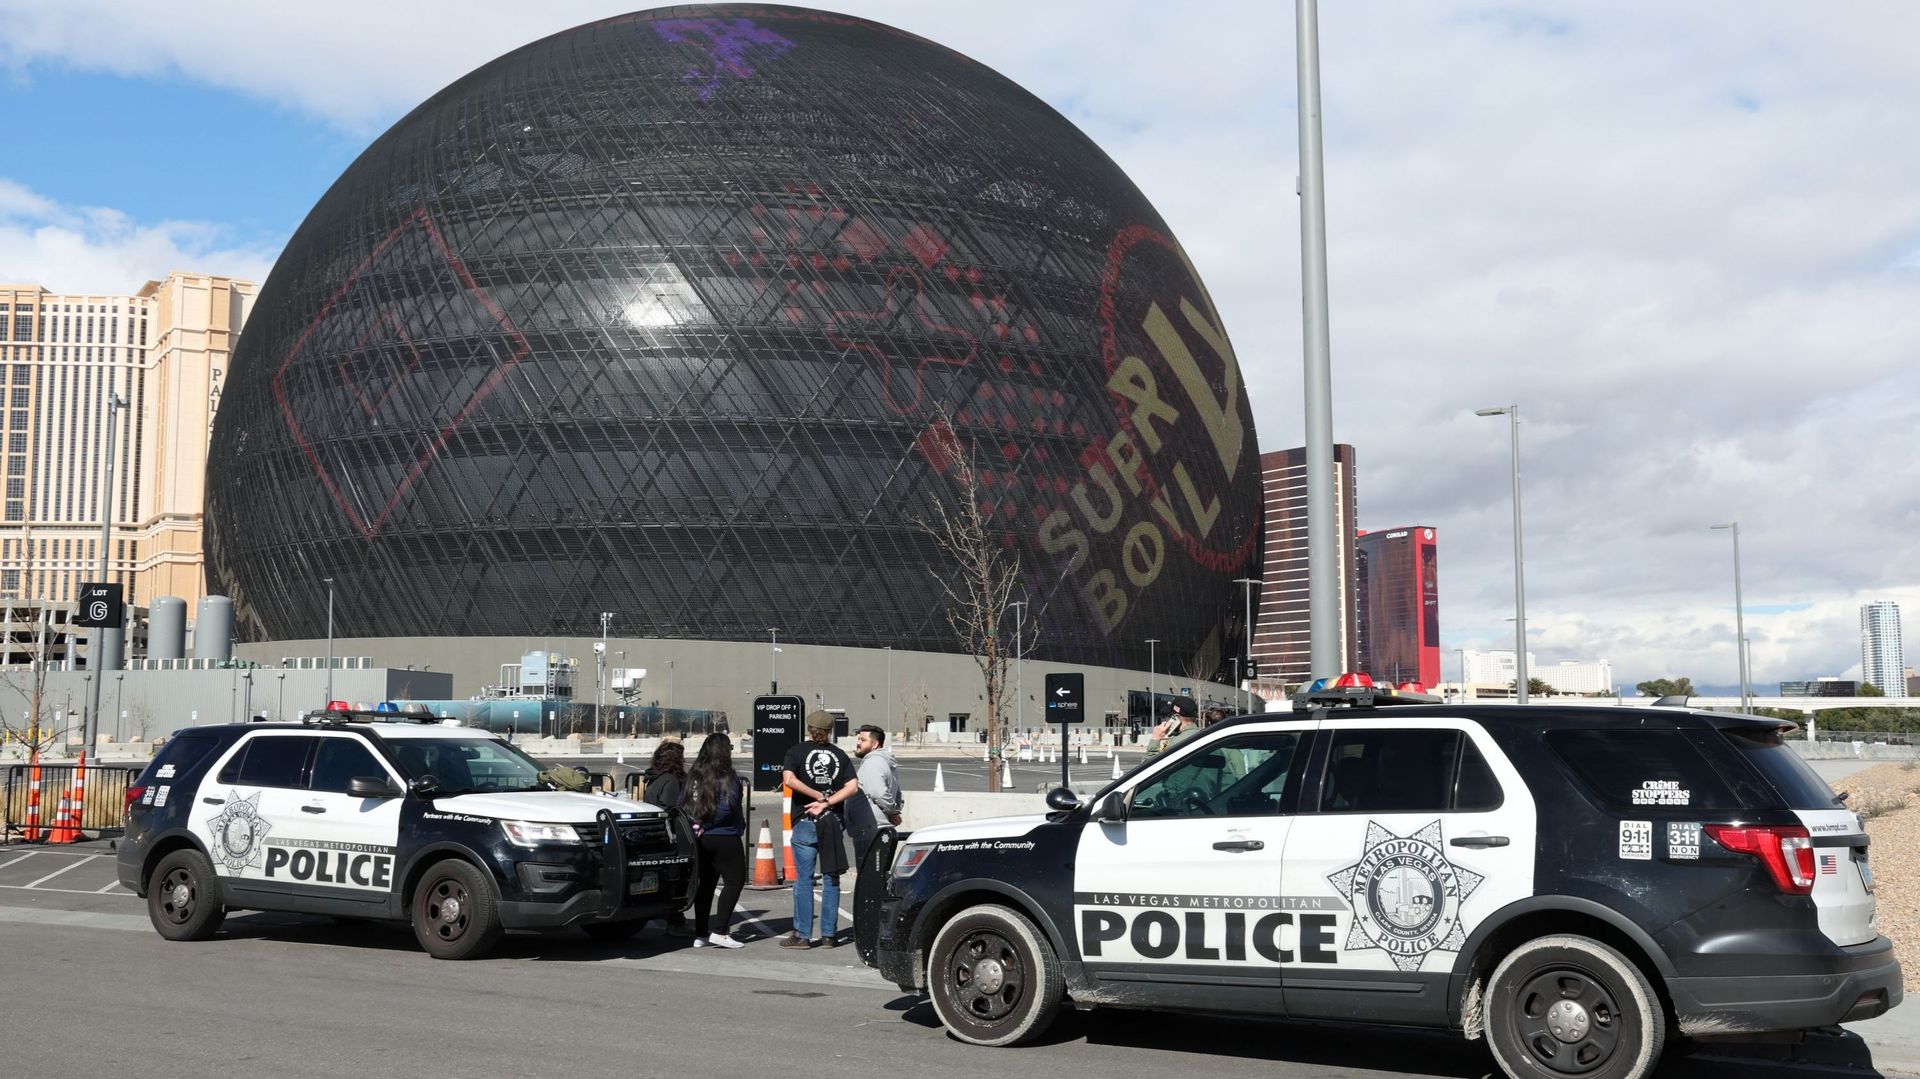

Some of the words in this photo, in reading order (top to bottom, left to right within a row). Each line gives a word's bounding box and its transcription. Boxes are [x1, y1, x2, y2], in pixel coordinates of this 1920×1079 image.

[1386, 531, 1407, 539] CONRAD
[90, 601, 108, 620] G
[1642, 780, 1680, 790] CRIME
[1631, 789, 1691, 799] STOPPERS
[423, 812, 443, 820] Partners
[463, 815, 493, 825] Community
[294, 840, 320, 849] VEGAS
[323, 842, 389, 854] METROPOLITAN
[937, 843, 964, 852] Partners
[964, 841, 980, 849] with
[980, 841, 993, 849] the
[993, 840, 1036, 851] Community
[1671, 846, 1698, 854] NON
[265, 847, 392, 888] POLICE
[659, 857, 689, 865] POLICE
[1353, 840, 1458, 898] METROPOLITAN
[1373, 857, 1395, 881] LAS
[1397, 857, 1436, 882] VEGAS
[1094, 894, 1120, 904] LAS
[1129, 895, 1180, 907] VEGAS
[1189, 896, 1322, 909] METROPOLITAN
[1375, 912, 1392, 930] CLARK
[1420, 913, 1438, 932] NEVADA
[1081, 909, 1338, 964] POLICE
[1376, 931, 1440, 954] POLICE
